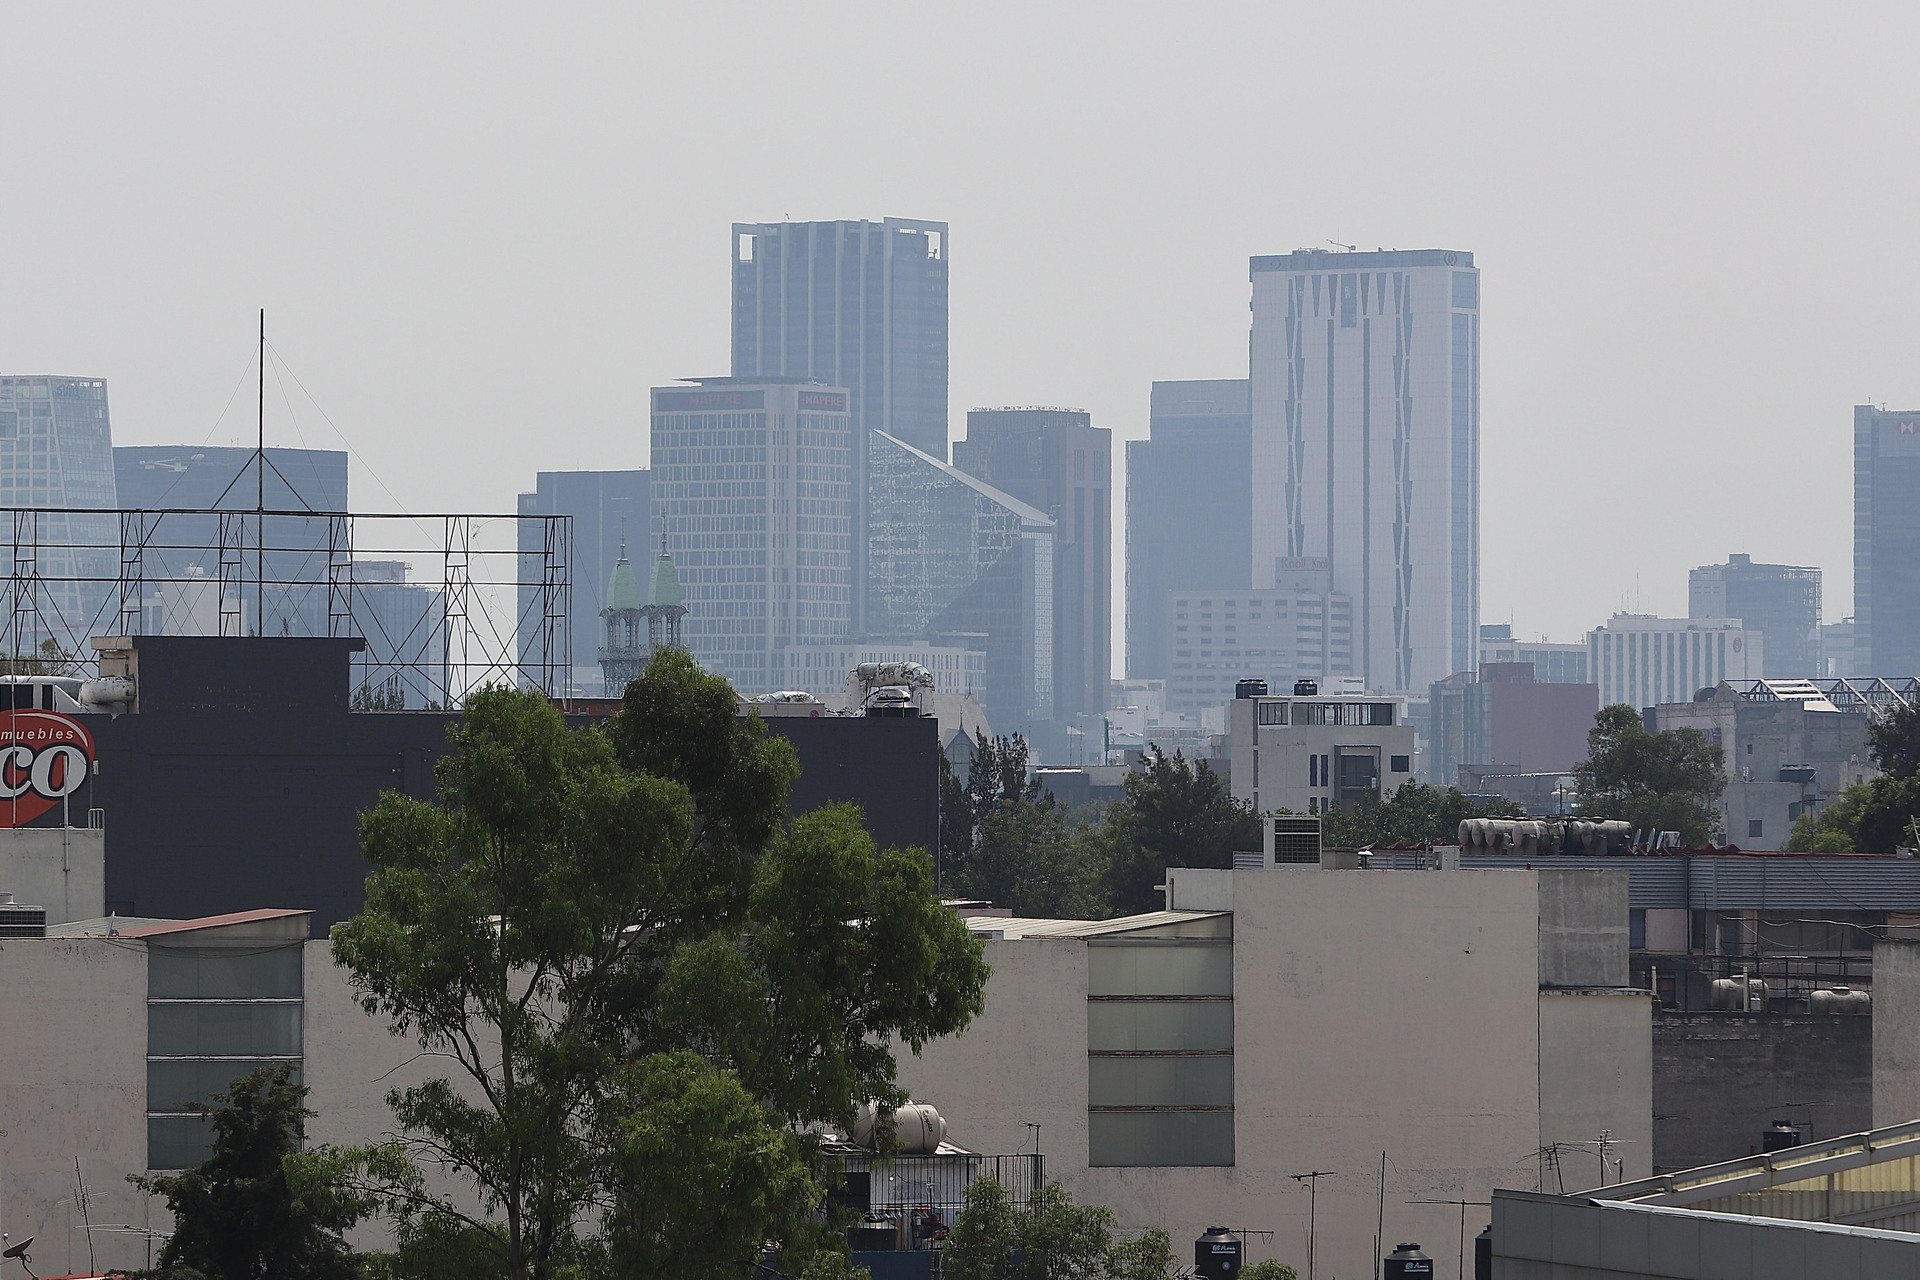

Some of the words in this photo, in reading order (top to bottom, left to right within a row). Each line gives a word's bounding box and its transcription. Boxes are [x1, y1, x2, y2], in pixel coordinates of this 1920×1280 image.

[688, 394, 741, 405] MAPFRE
[805, 395, 843, 407] MAPFRE
[1281, 558, 1306, 568] Knoll
[1, 727, 74, 740] muebles
